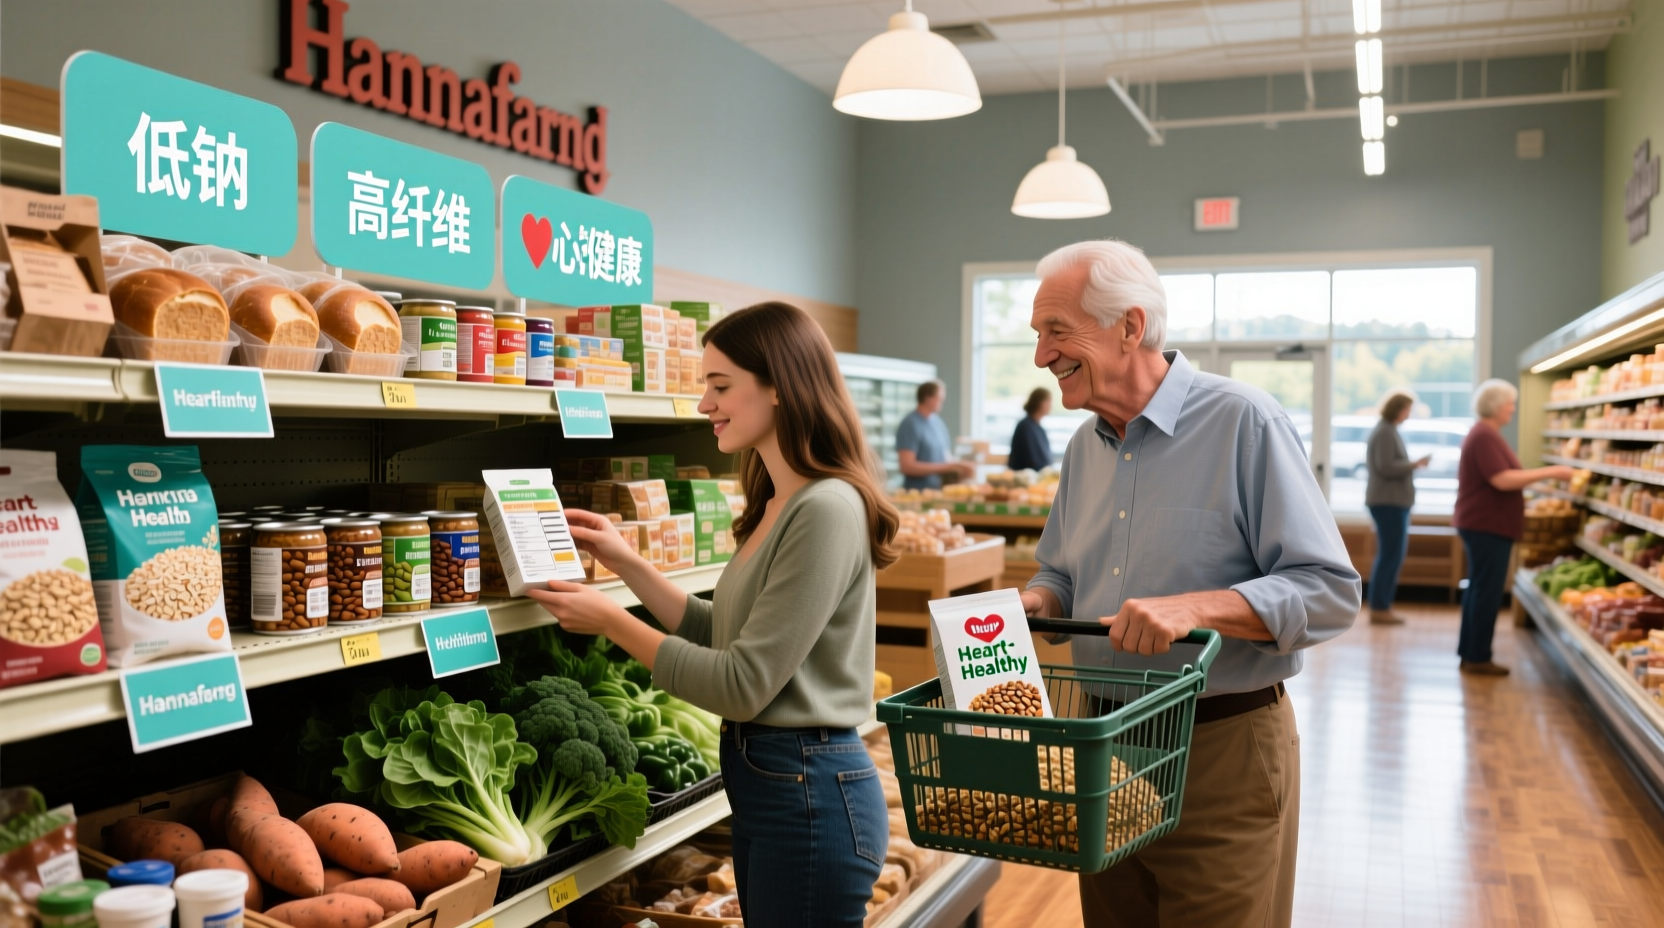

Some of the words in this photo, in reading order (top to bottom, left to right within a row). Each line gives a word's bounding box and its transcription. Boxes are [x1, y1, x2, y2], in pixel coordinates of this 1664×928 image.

[127, 111, 248, 210] 低钠
[347, 170, 471, 254] 高纤维
[0, 494, 38, 512] art
[961, 655, 1028, 680] Healthy
